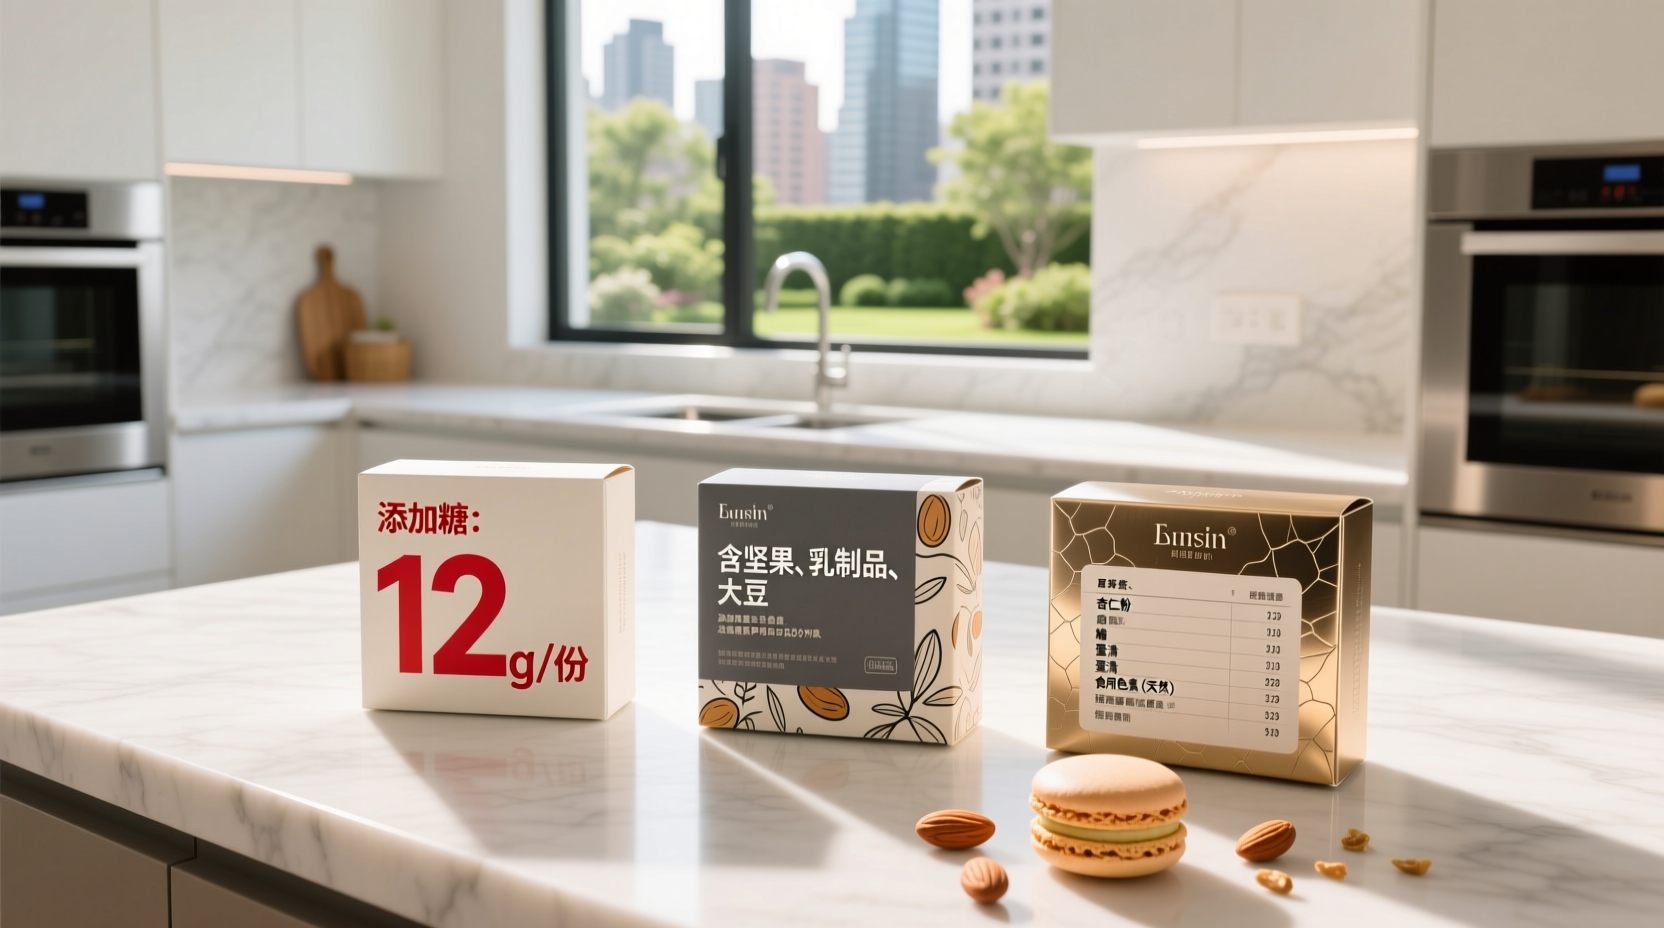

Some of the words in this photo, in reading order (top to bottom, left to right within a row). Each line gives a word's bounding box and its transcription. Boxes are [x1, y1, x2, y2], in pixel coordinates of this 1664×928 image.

[717, 543, 899, 581] 含坚果、乳制品、
[717, 578, 769, 607] 大豆
